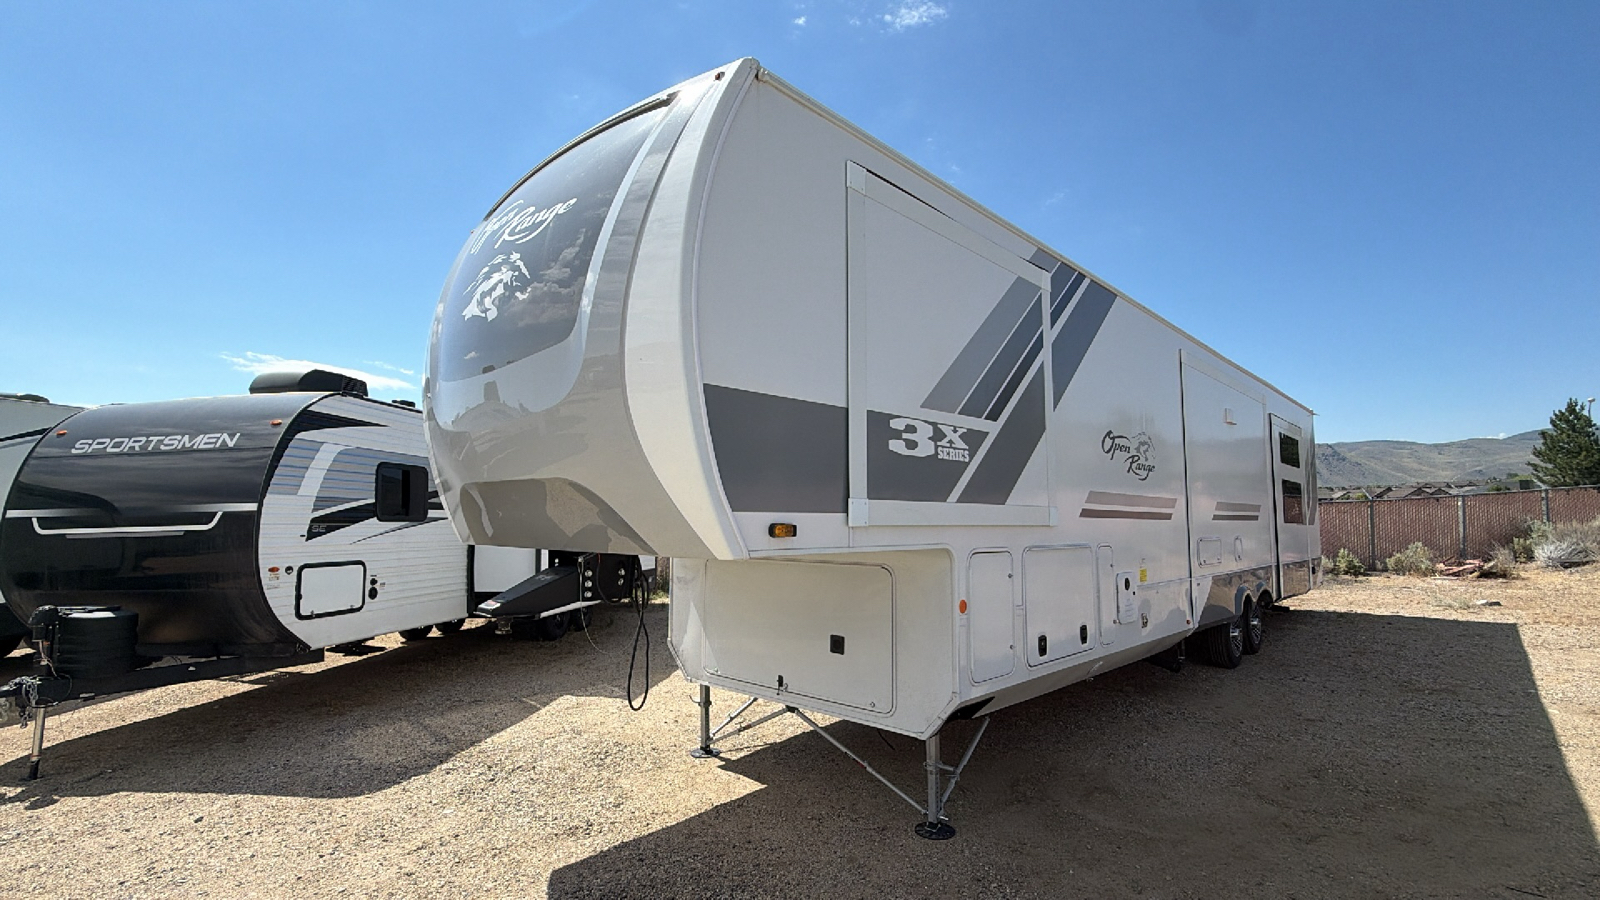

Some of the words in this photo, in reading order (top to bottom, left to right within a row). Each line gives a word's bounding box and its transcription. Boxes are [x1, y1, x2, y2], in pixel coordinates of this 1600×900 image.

[494, 198, 578, 249] Range
[71, 432, 241, 454] SPORTSMEN
[937, 447, 970, 463] SERIES
[1101, 429, 1132, 461] Open
[1123, 454, 1156, 481] Range
